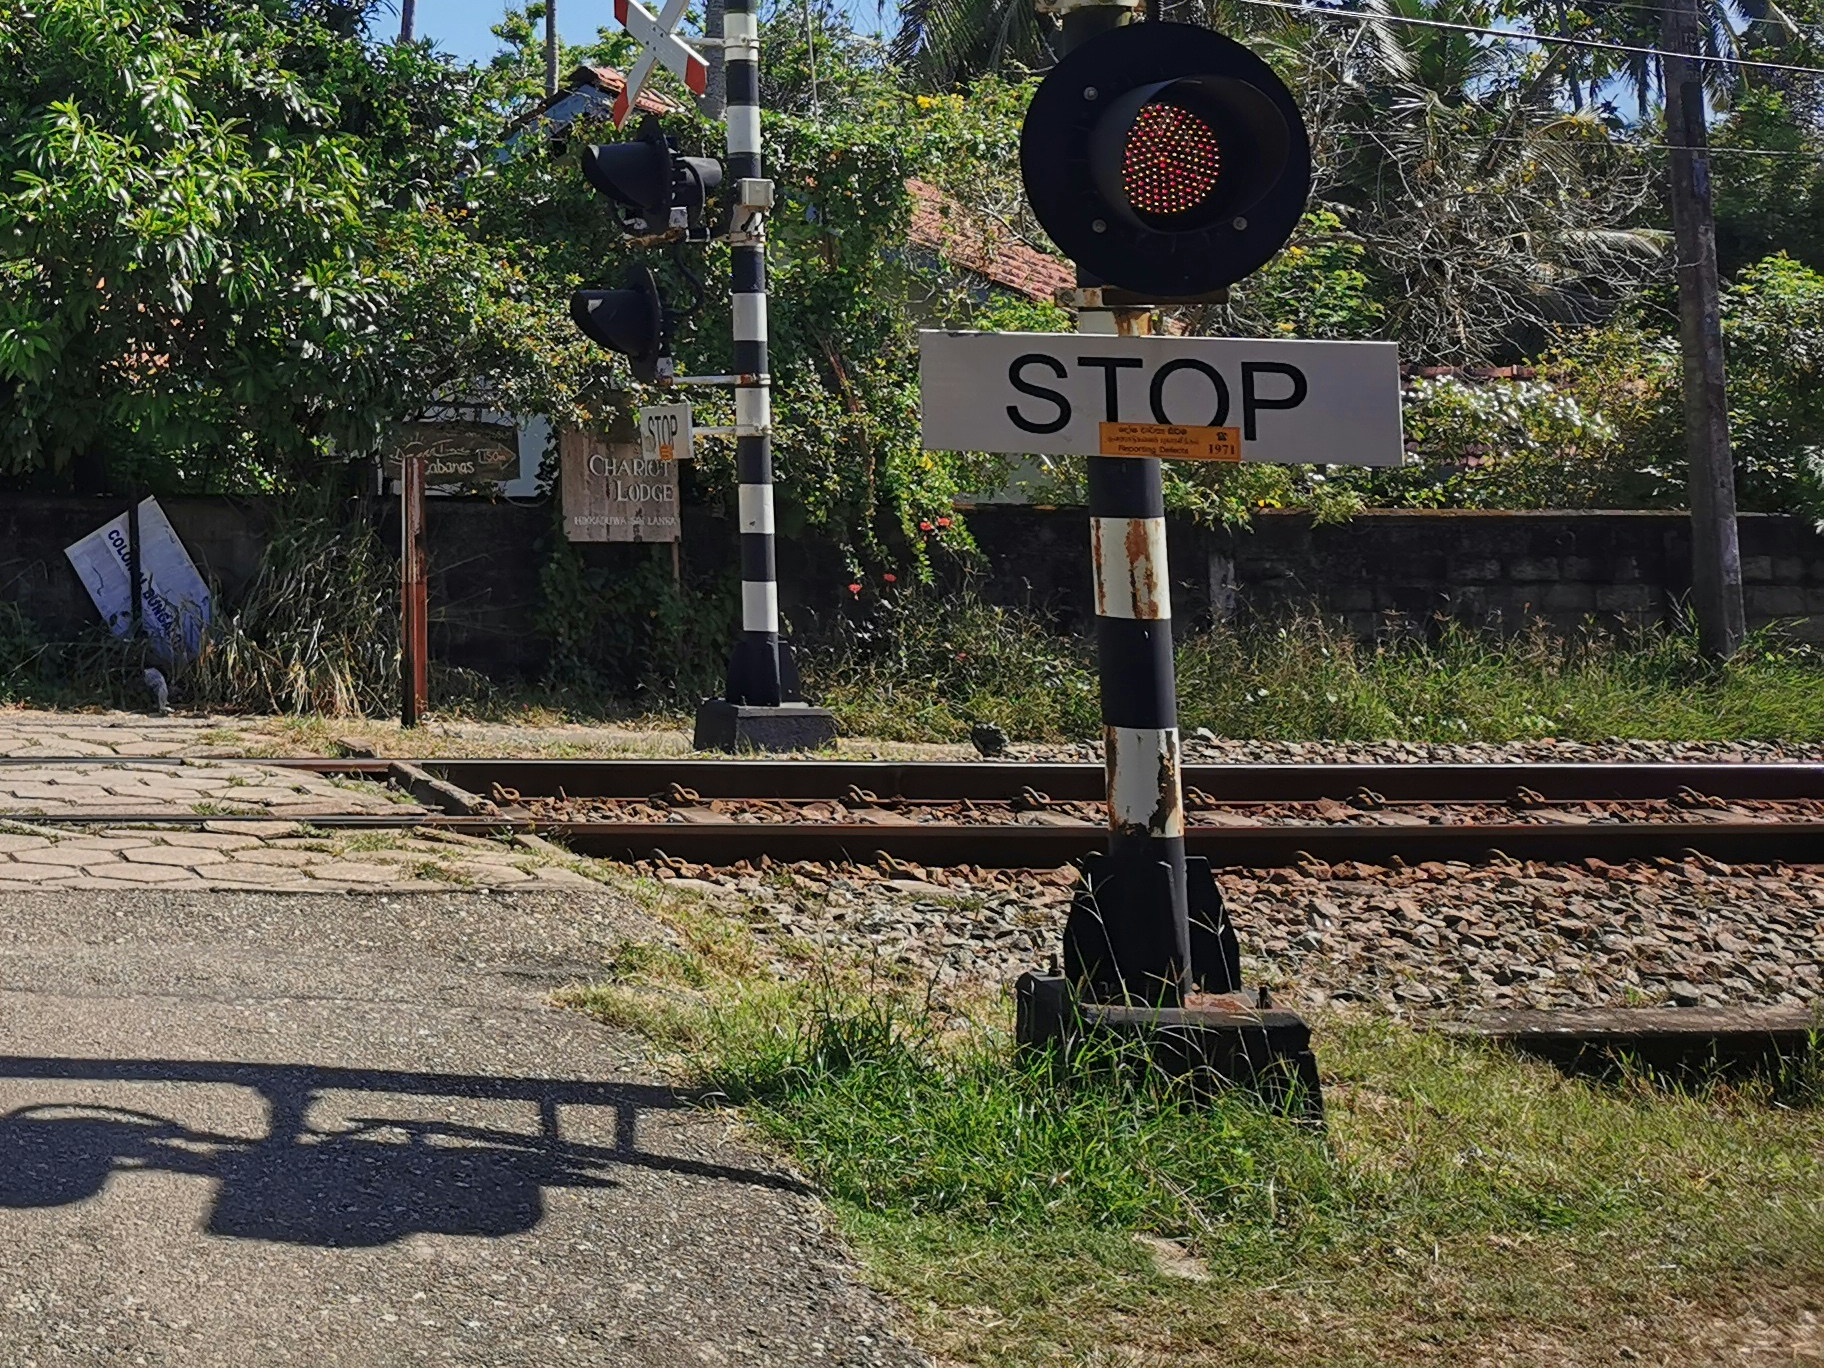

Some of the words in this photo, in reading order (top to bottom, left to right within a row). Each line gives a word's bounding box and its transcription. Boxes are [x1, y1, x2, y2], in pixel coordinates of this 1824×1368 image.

[1006, 353, 1308, 441] STOP
[648, 414, 678, 452] STOP
[1118, 445, 1156, 454] Reporting
[1159, 446, 1189, 454] Defects
[1208, 443, 1235, 455] 1971
[588, 454, 669, 477] CHARIOT
[616, 480, 674, 503] LODGE
[108, 529, 147, 585] COLONAL
